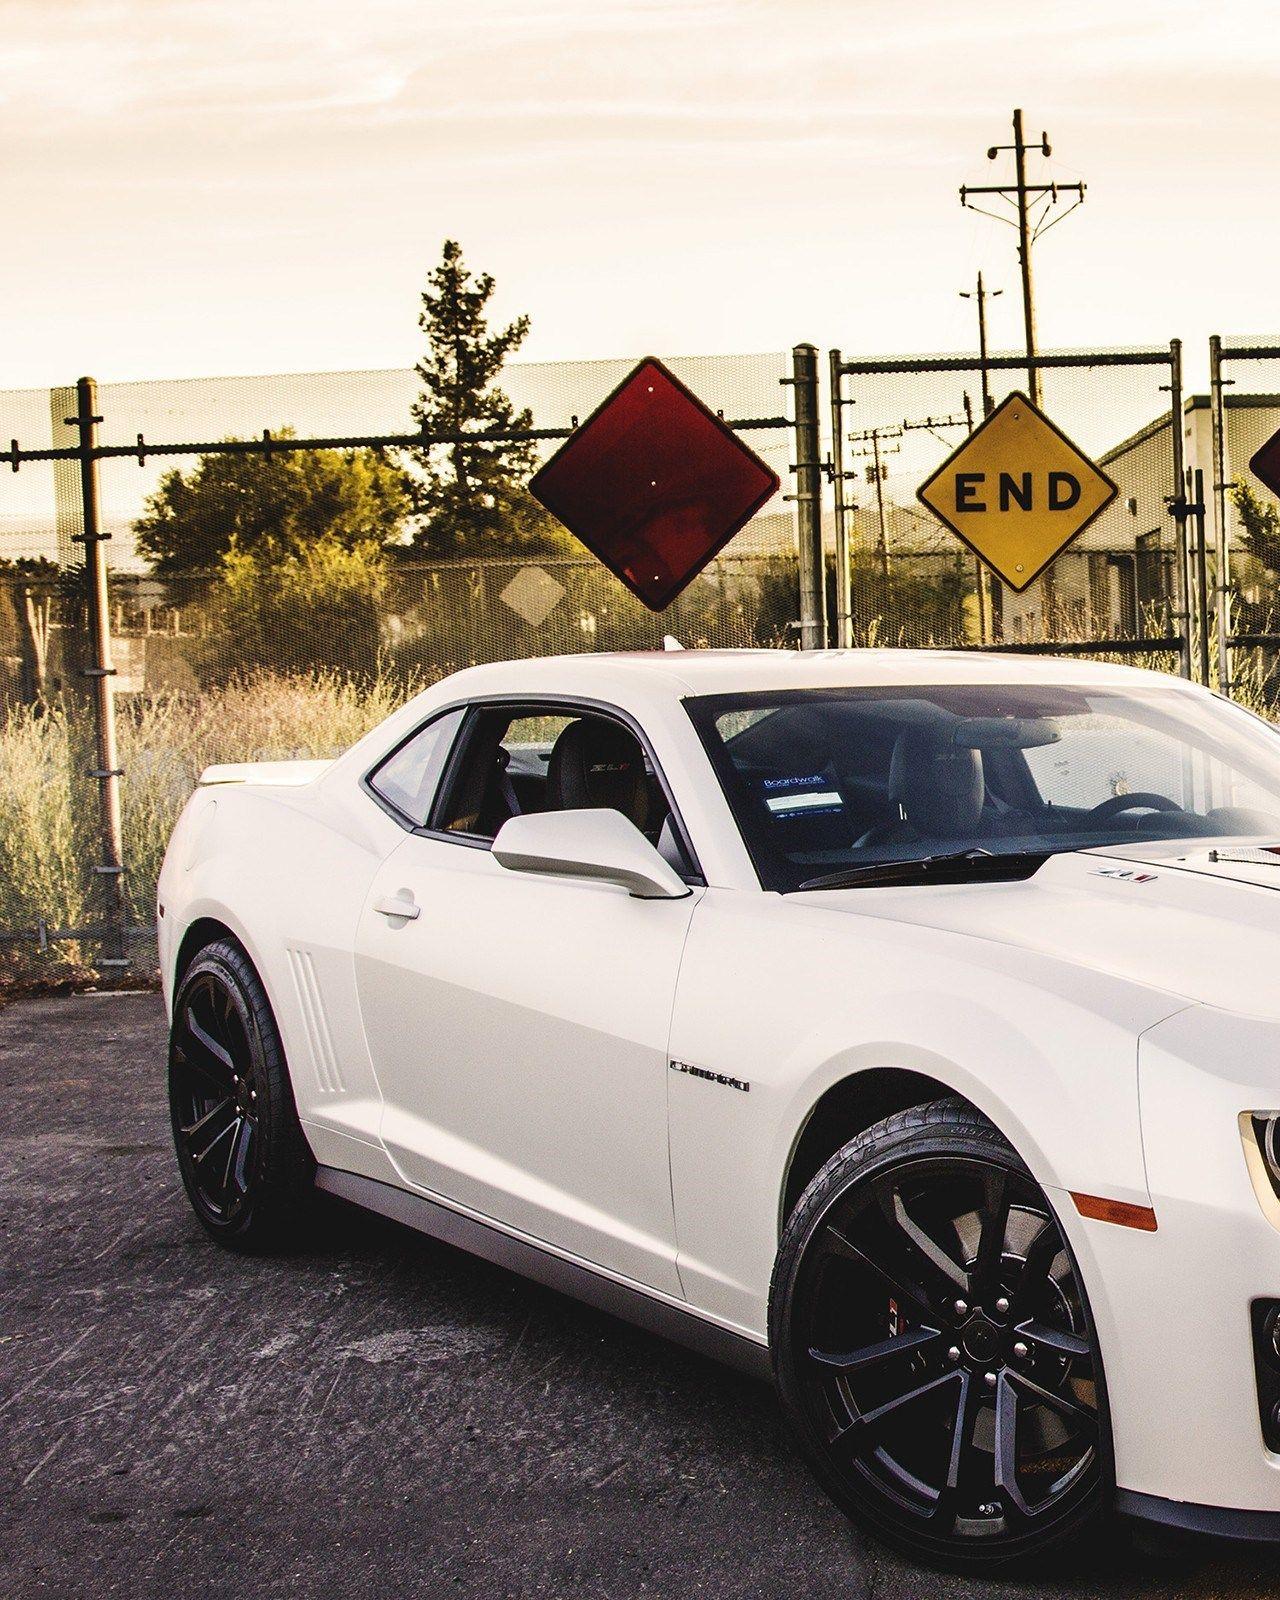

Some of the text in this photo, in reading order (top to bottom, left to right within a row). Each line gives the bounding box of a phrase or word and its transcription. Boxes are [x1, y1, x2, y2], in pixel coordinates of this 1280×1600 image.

[955, 471, 1082, 513] END
[763, 775, 823, 787] Boardwalk
[669, 1059, 750, 1092] CAMARO
